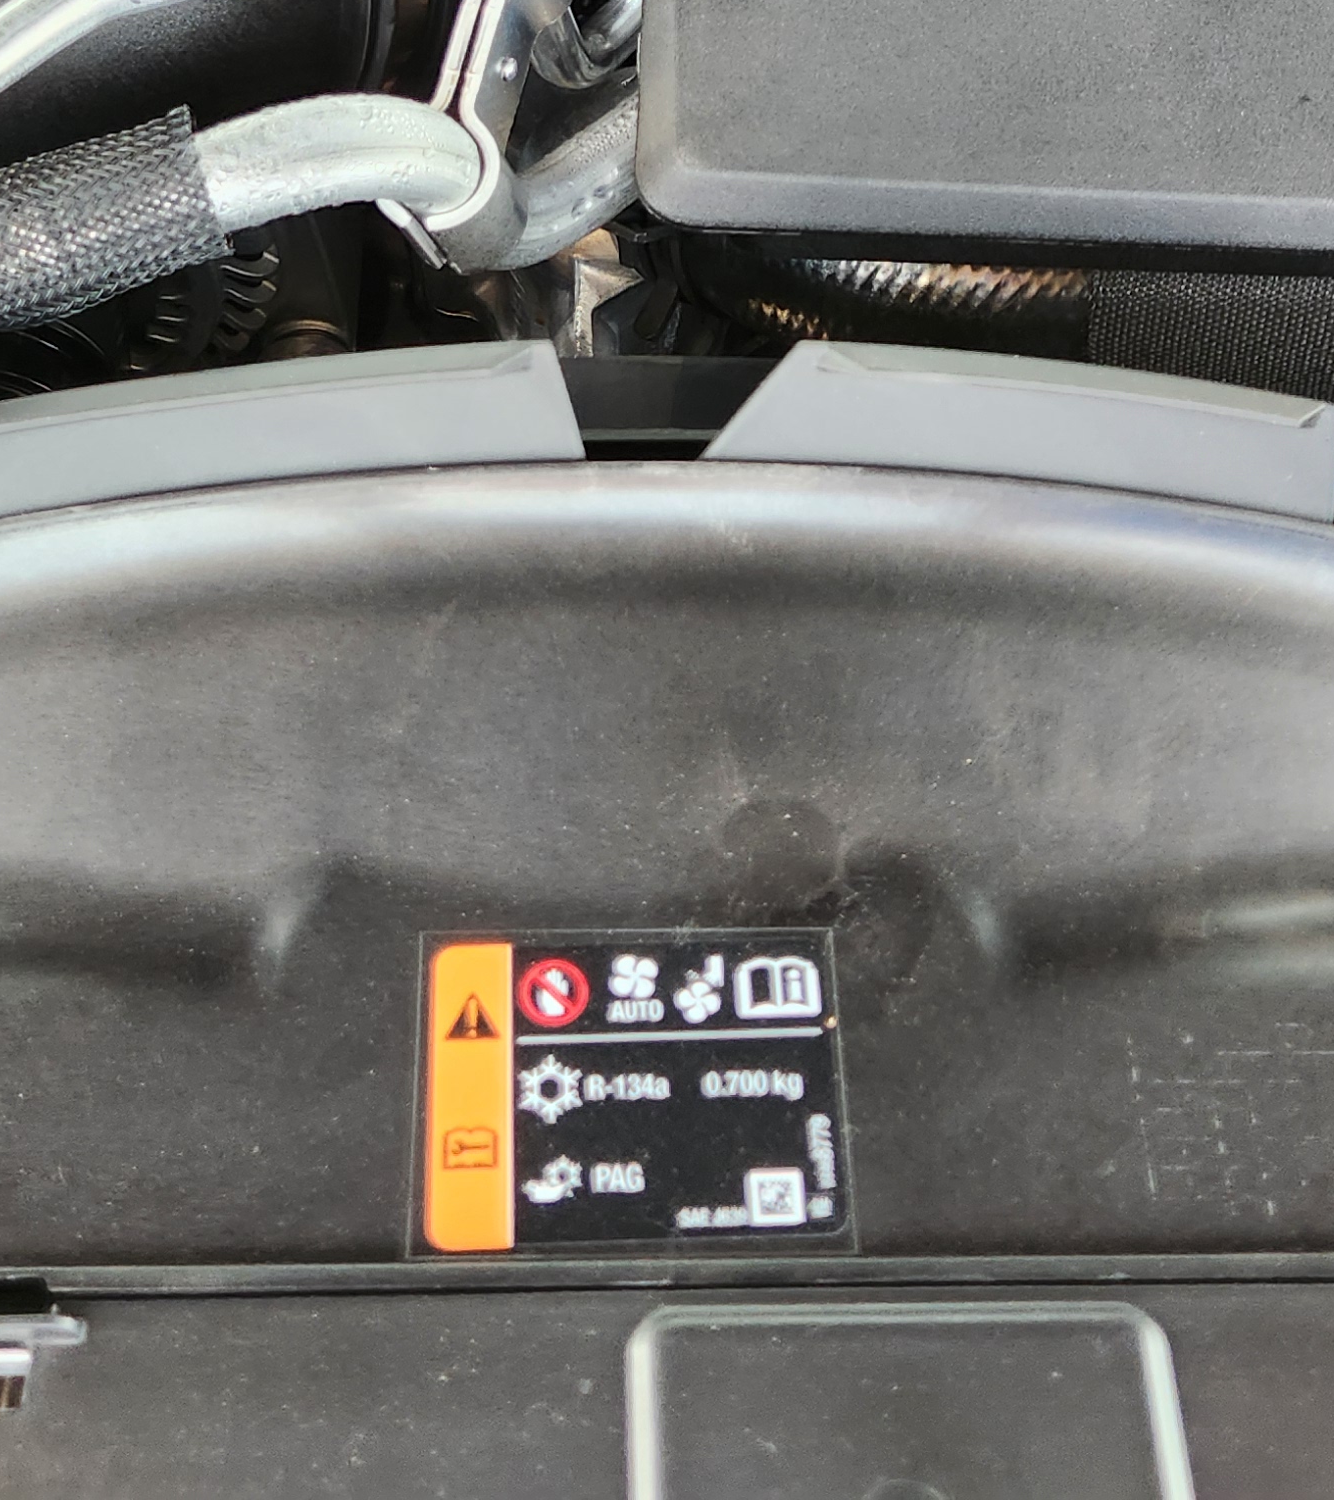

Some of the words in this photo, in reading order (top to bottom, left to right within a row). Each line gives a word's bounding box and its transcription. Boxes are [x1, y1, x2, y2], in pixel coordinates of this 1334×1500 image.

[607, 999, 664, 1023] AUTO
[583, 1073, 670, 1100] R-134a
[701, 1071, 768, 1098] 0.700
[771, 1071, 804, 1100] kg
[590, 1162, 645, 1194] PAG
